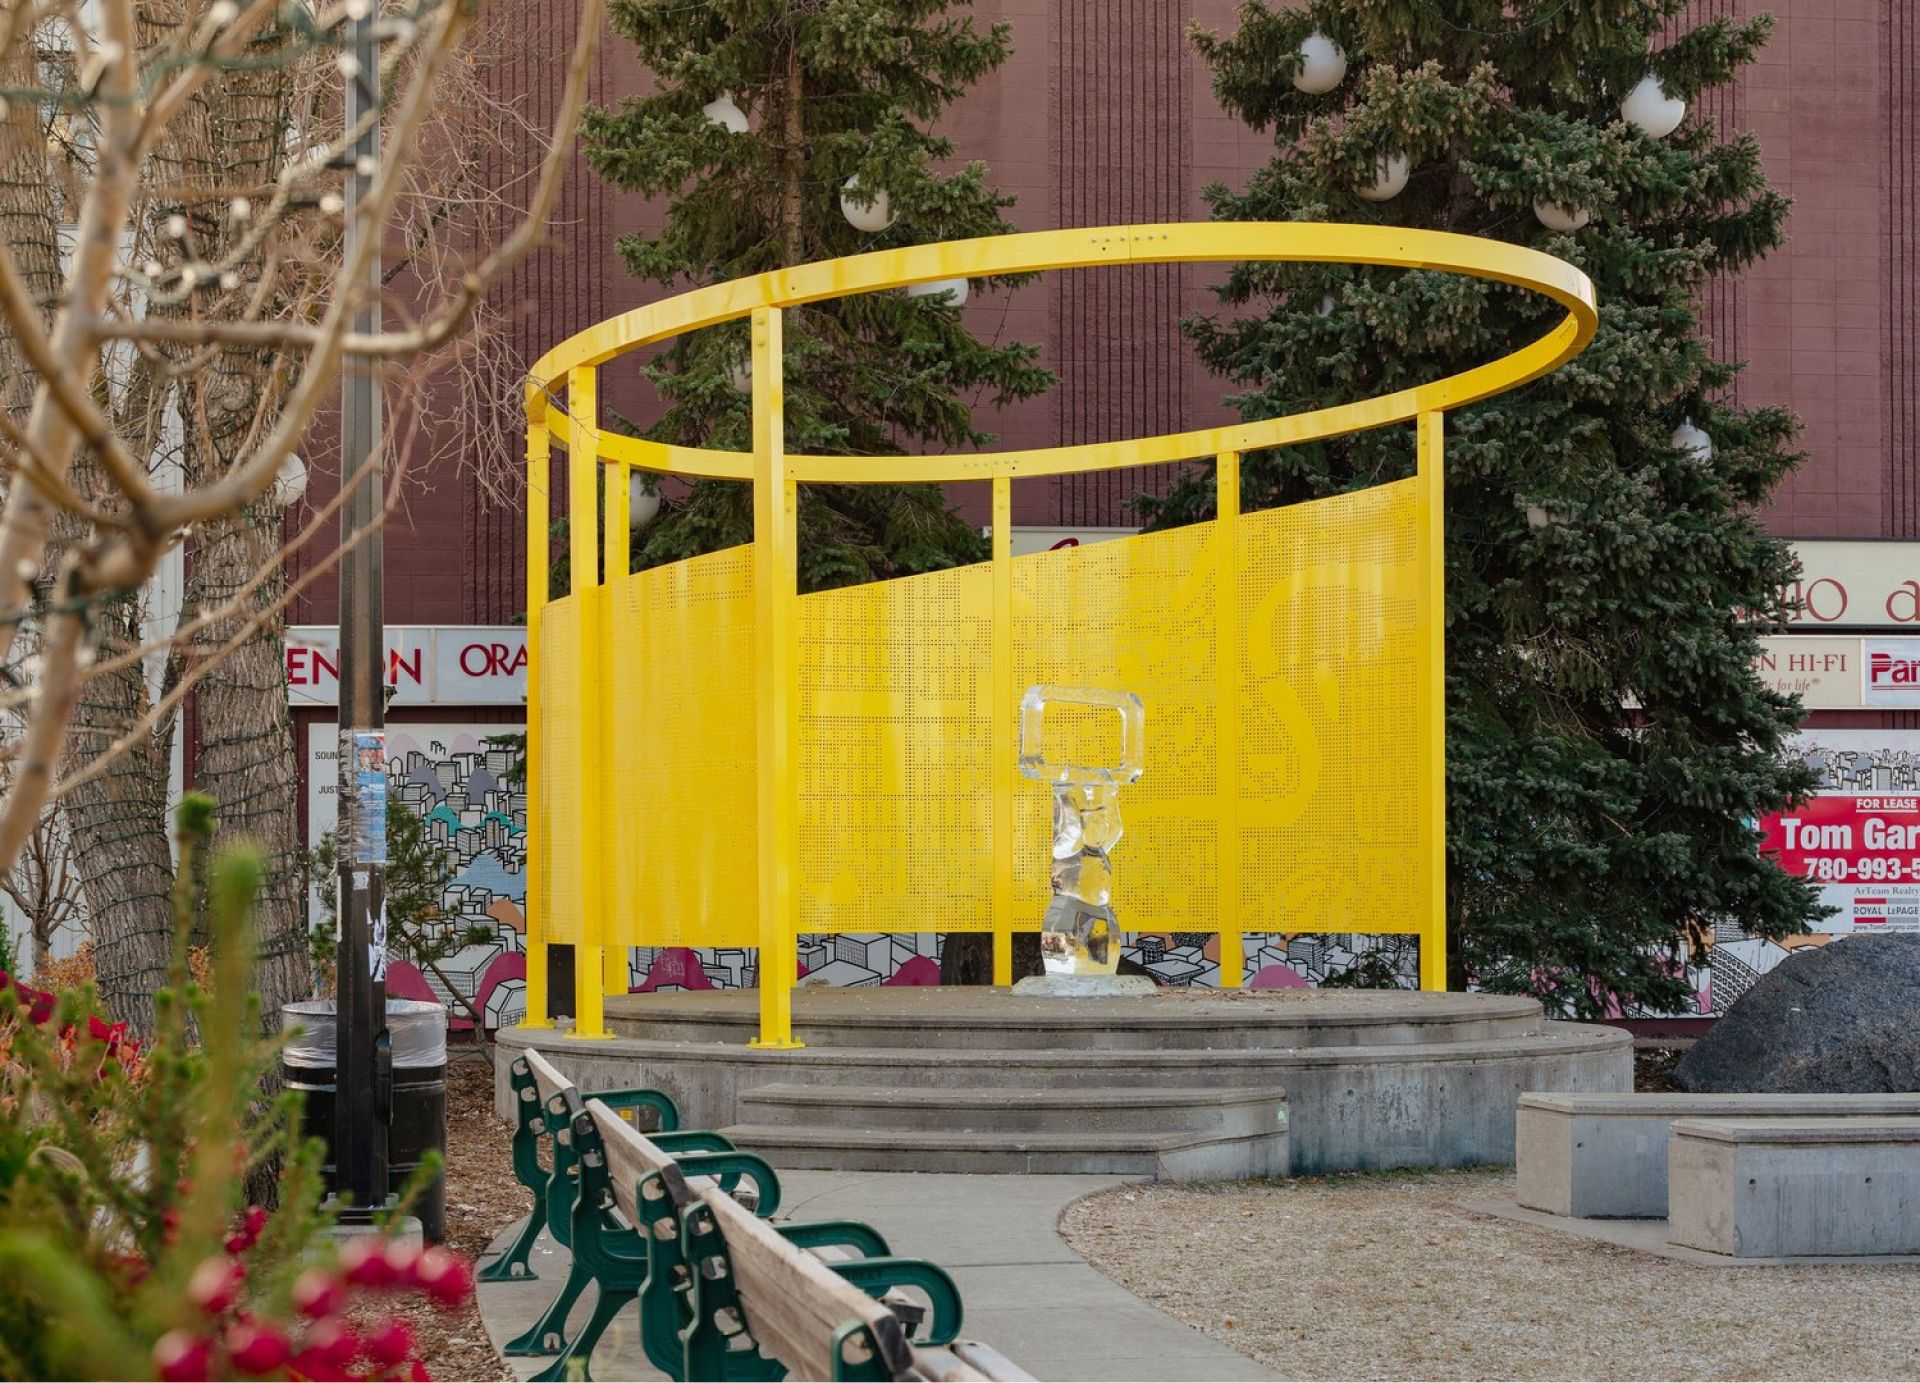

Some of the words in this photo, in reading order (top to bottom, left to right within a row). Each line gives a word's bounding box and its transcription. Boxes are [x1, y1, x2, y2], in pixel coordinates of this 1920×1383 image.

[287, 648, 421, 685] ENN
[1789, 654, 1847, 671] HI-FI
[1776, 678, 1792, 693] for
[1856, 799, 1880, 809] FOR
[1883, 799, 1917, 809] LEASE
[1780, 818, 1852, 850] Tom
[1892, 886, 1919, 897] Realty
[1853, 906, 1882, 915] ROYAL
